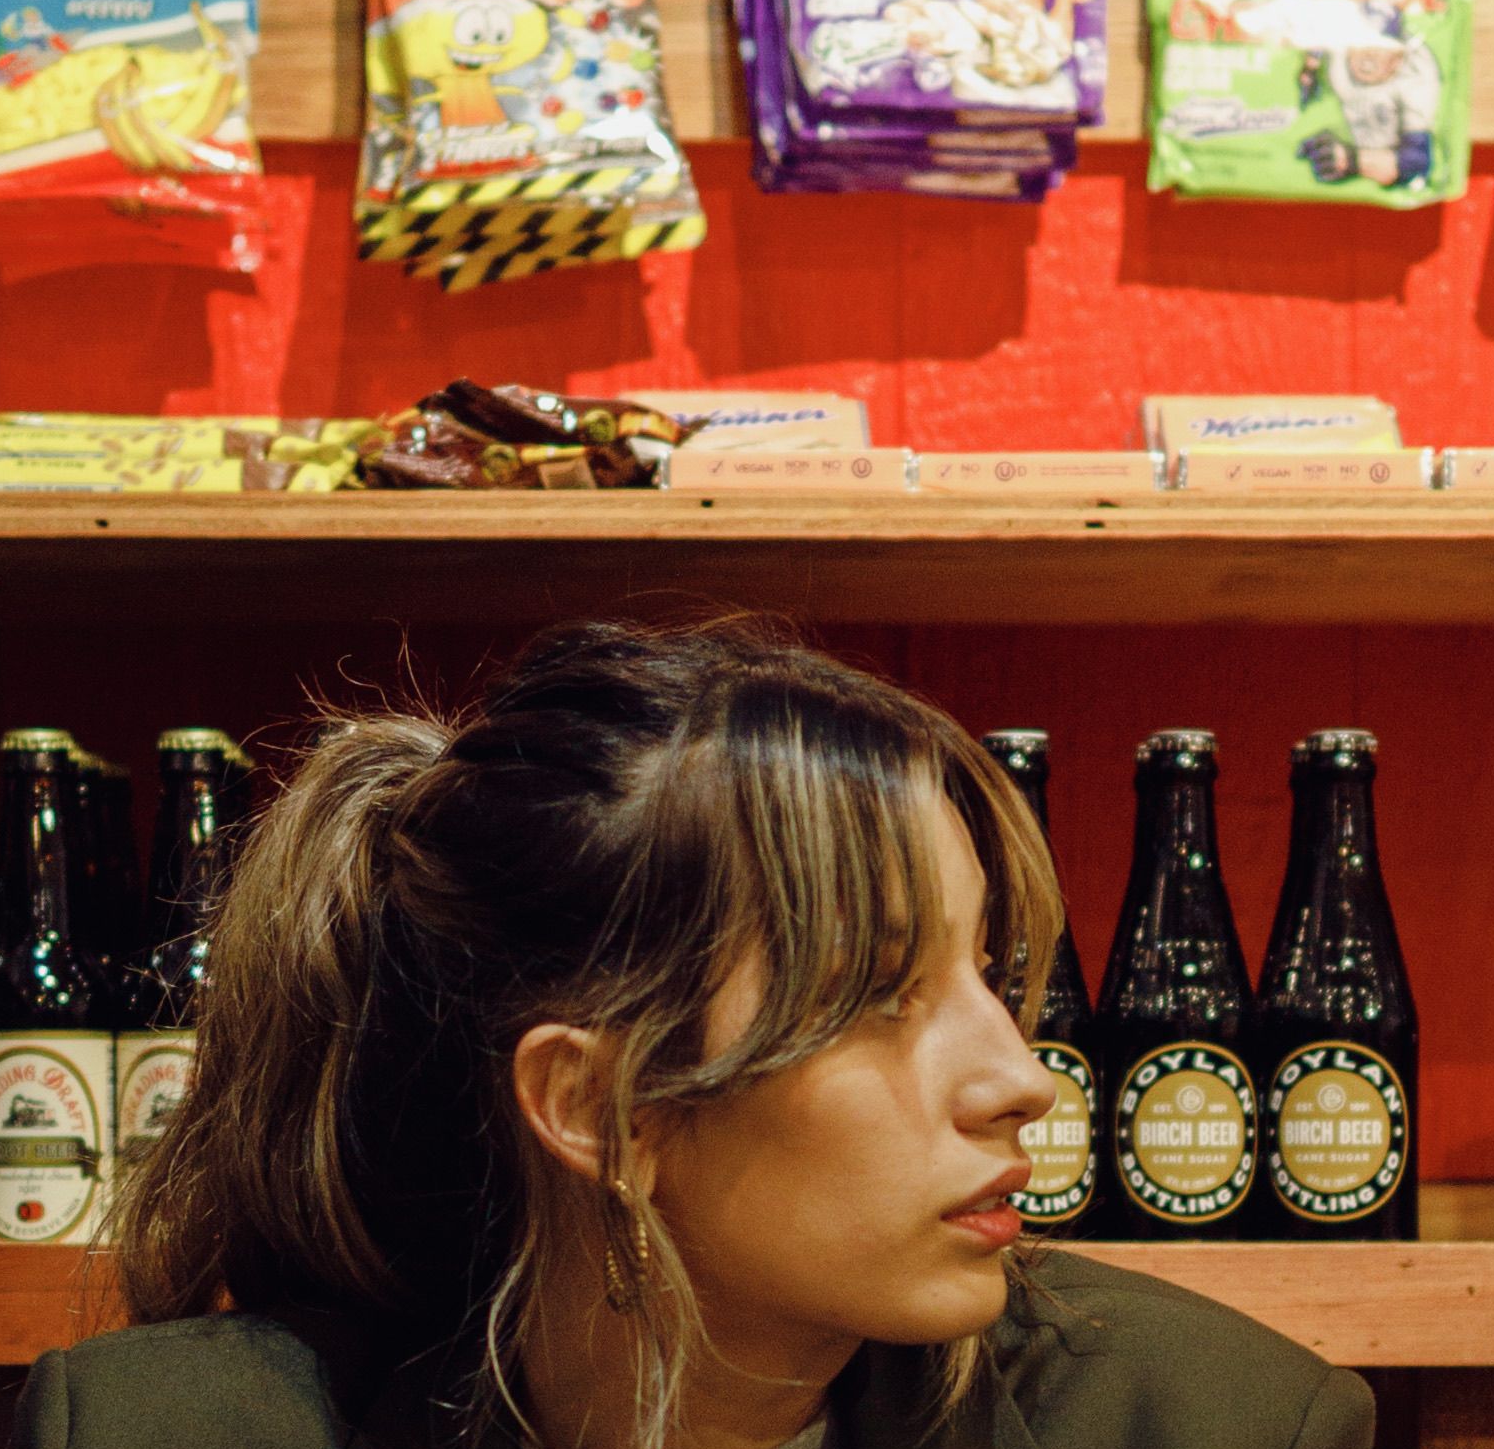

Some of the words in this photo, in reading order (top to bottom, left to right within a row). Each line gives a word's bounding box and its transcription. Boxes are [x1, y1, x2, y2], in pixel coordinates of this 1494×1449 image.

[735, 462, 775, 474] VEGAN
[1252, 468, 1291, 478] VEGAN
[1123, 1050, 1254, 1112] BOYLAN
[1270, 1050, 1402, 1112] BOYLAN
[39, 1067, 85, 1132] DRAFT
[1052, 1120, 1087, 1146] BEER
[1139, 1120, 1193, 1147] BIRCH
[1198, 1120, 1239, 1147] BEER
[1283, 1119, 1335, 1146] BIRCH
[1338, 1119, 1383, 1145] BEER
[34, 1142, 80, 1159] BEER
[1153, 1153, 1183, 1164] CANE
[1189, 1153, 1228, 1164] SUGAR
[1295, 1152, 1326, 1164] CANE
[1329, 1152, 1371, 1164] SUGAR
[1122, 1154, 1234, 1214] BOTTLING
[1271, 1153, 1376, 1213] BOTTLING
